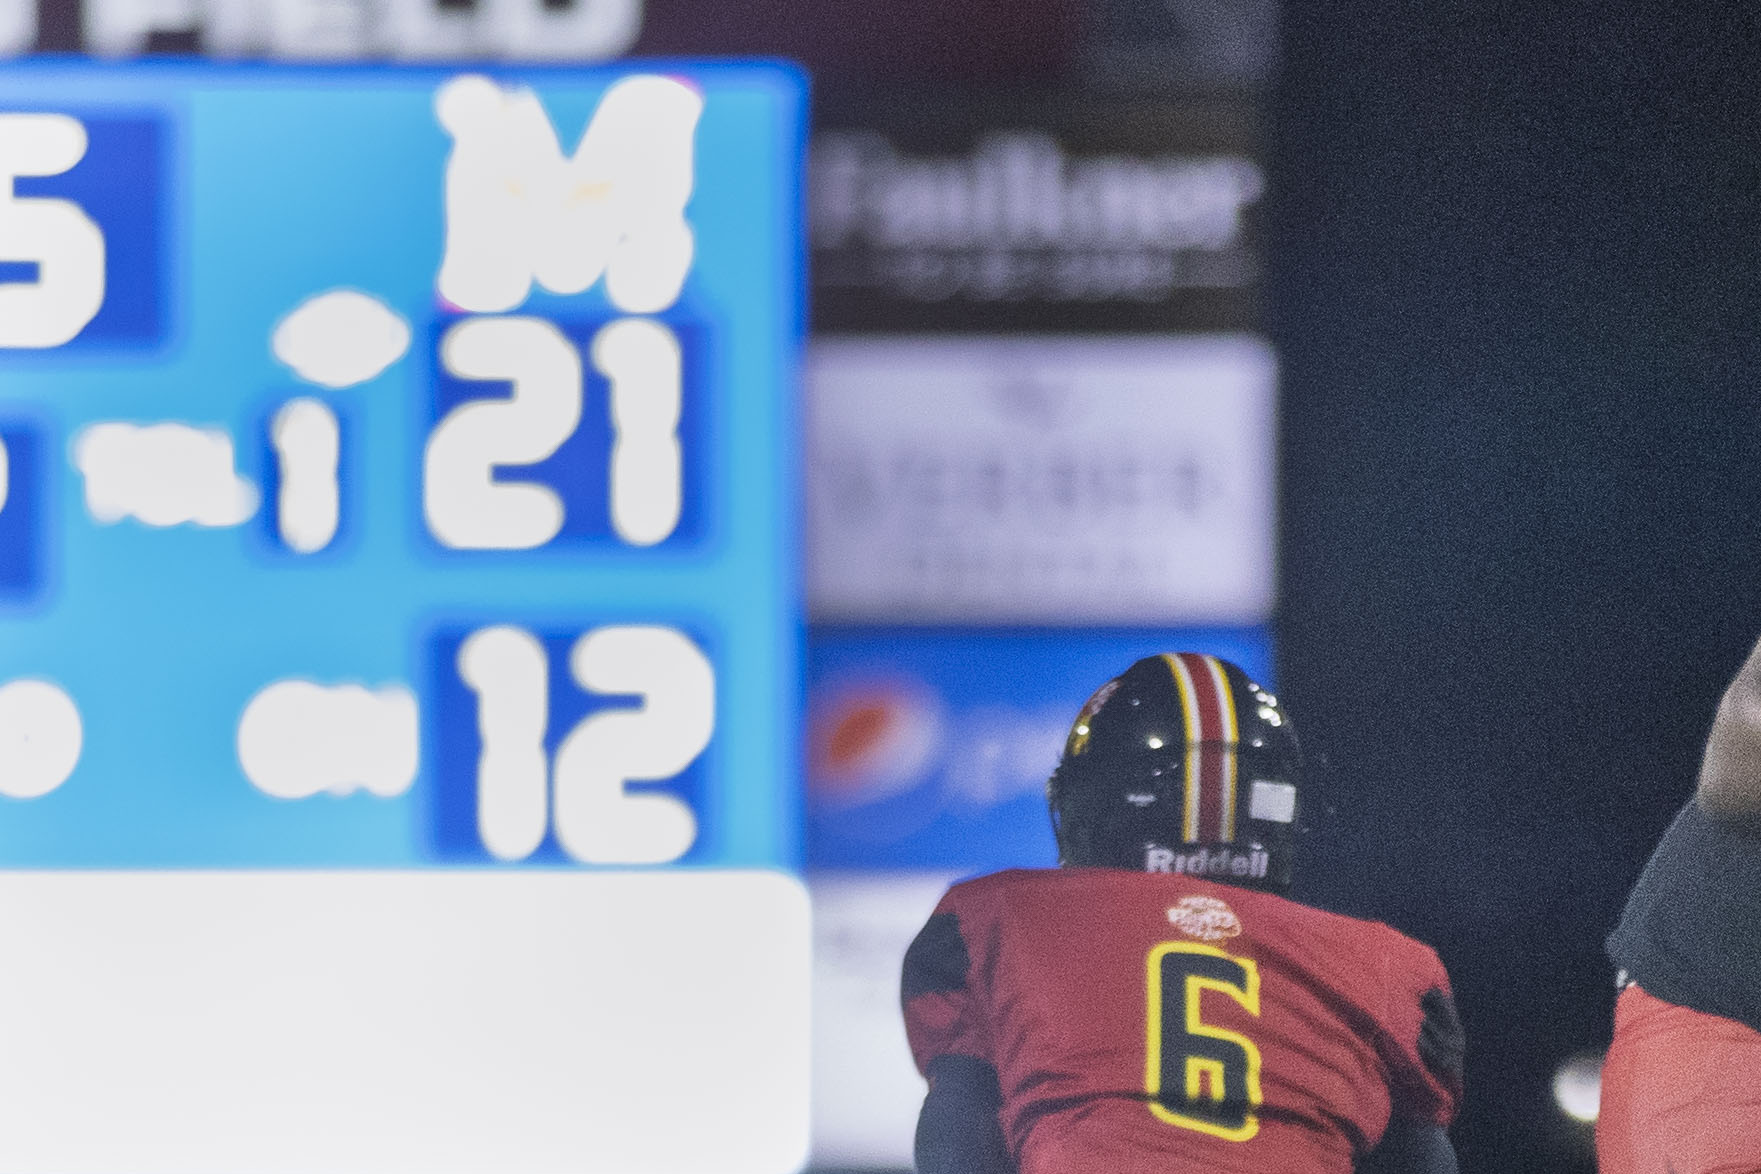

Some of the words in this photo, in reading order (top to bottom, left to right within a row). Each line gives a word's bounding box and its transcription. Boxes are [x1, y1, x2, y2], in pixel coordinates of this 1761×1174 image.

[424, 316, 682, 550] 21
[457, 624, 716, 865] 12
[1145, 847, 1269, 879] Riddell
[1146, 940, 1261, 1142] 6
